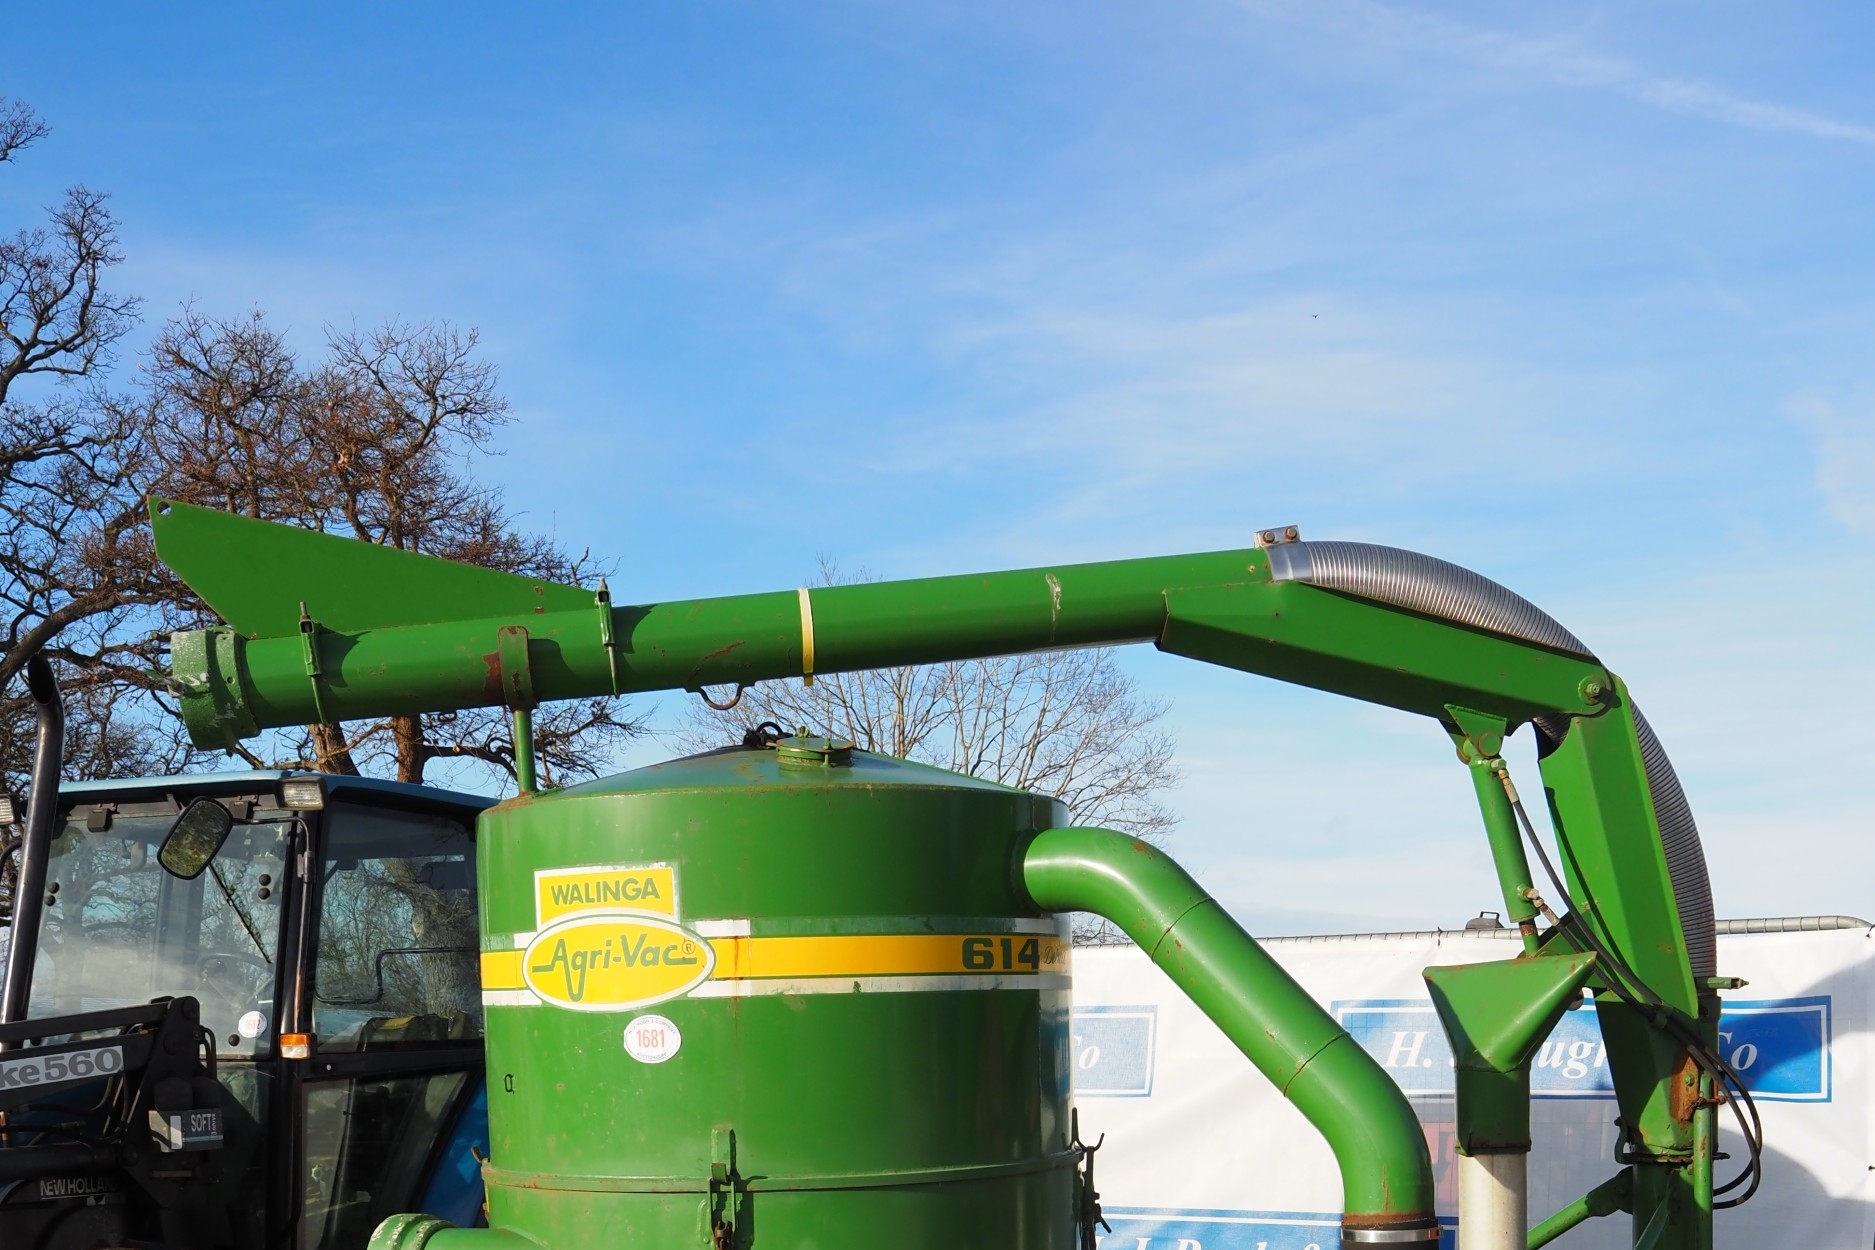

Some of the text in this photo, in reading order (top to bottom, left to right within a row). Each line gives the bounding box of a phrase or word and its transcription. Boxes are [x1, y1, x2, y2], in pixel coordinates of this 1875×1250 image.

[550, 877, 661, 905] WALINGA
[962, 937, 1040, 970] 614
[637, 1029, 665, 1048] 1681
[1073, 1034, 1100, 1070] o
[44, 1048, 121, 1081] 560
[1384, 1031, 1433, 1069] H.
[1537, 1039, 1607, 1079] ug
[191, 1113, 212, 1132] SOFT
[40, 1176, 118, 1197] NEW HOLLAN
